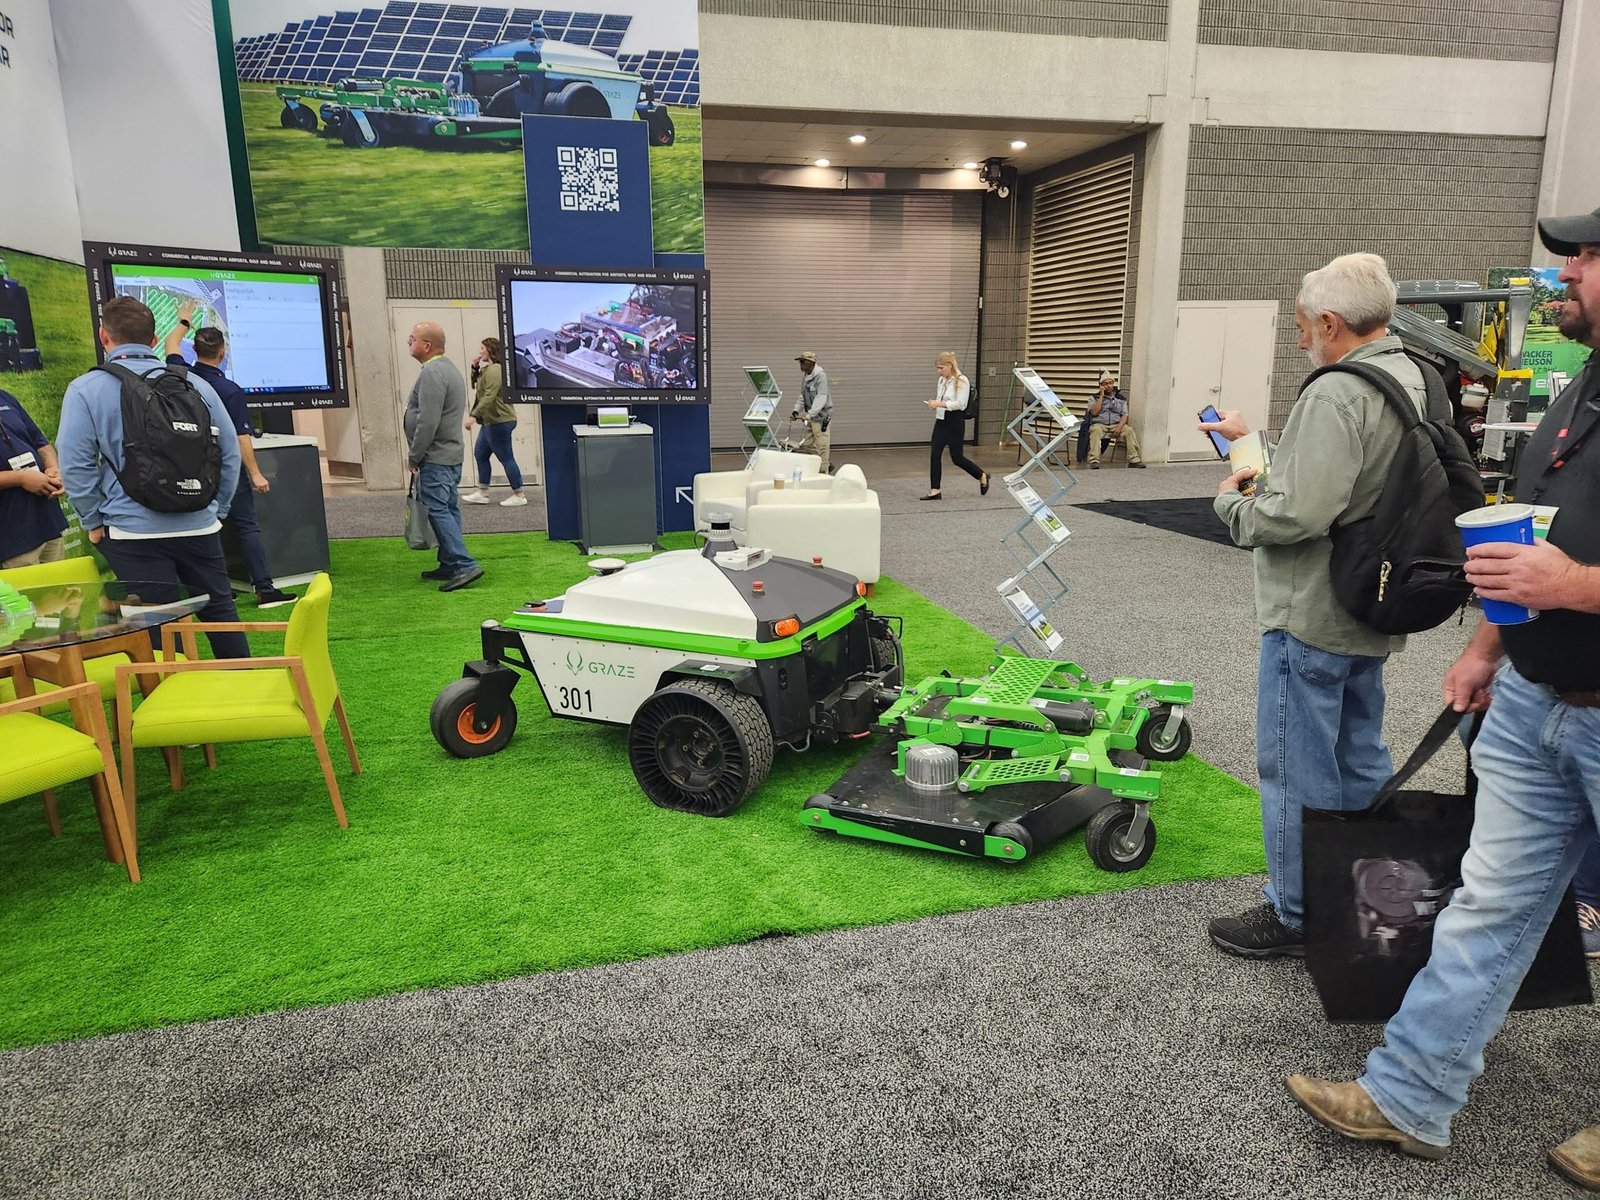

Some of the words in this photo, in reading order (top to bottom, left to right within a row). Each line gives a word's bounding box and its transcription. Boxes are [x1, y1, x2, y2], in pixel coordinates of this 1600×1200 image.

[118, 249, 138, 257] GRAZE
[161, 252, 190, 260] COMMERCIAL
[191, 254, 219, 262] AUTOMATION
[307, 262, 322, 270] GRAZE
[215, 272, 236, 280] GRAZE
[172, 421, 198, 432] FORT
[588, 661, 635, 679] GRAZE
[560, 686, 592, 713] 301
